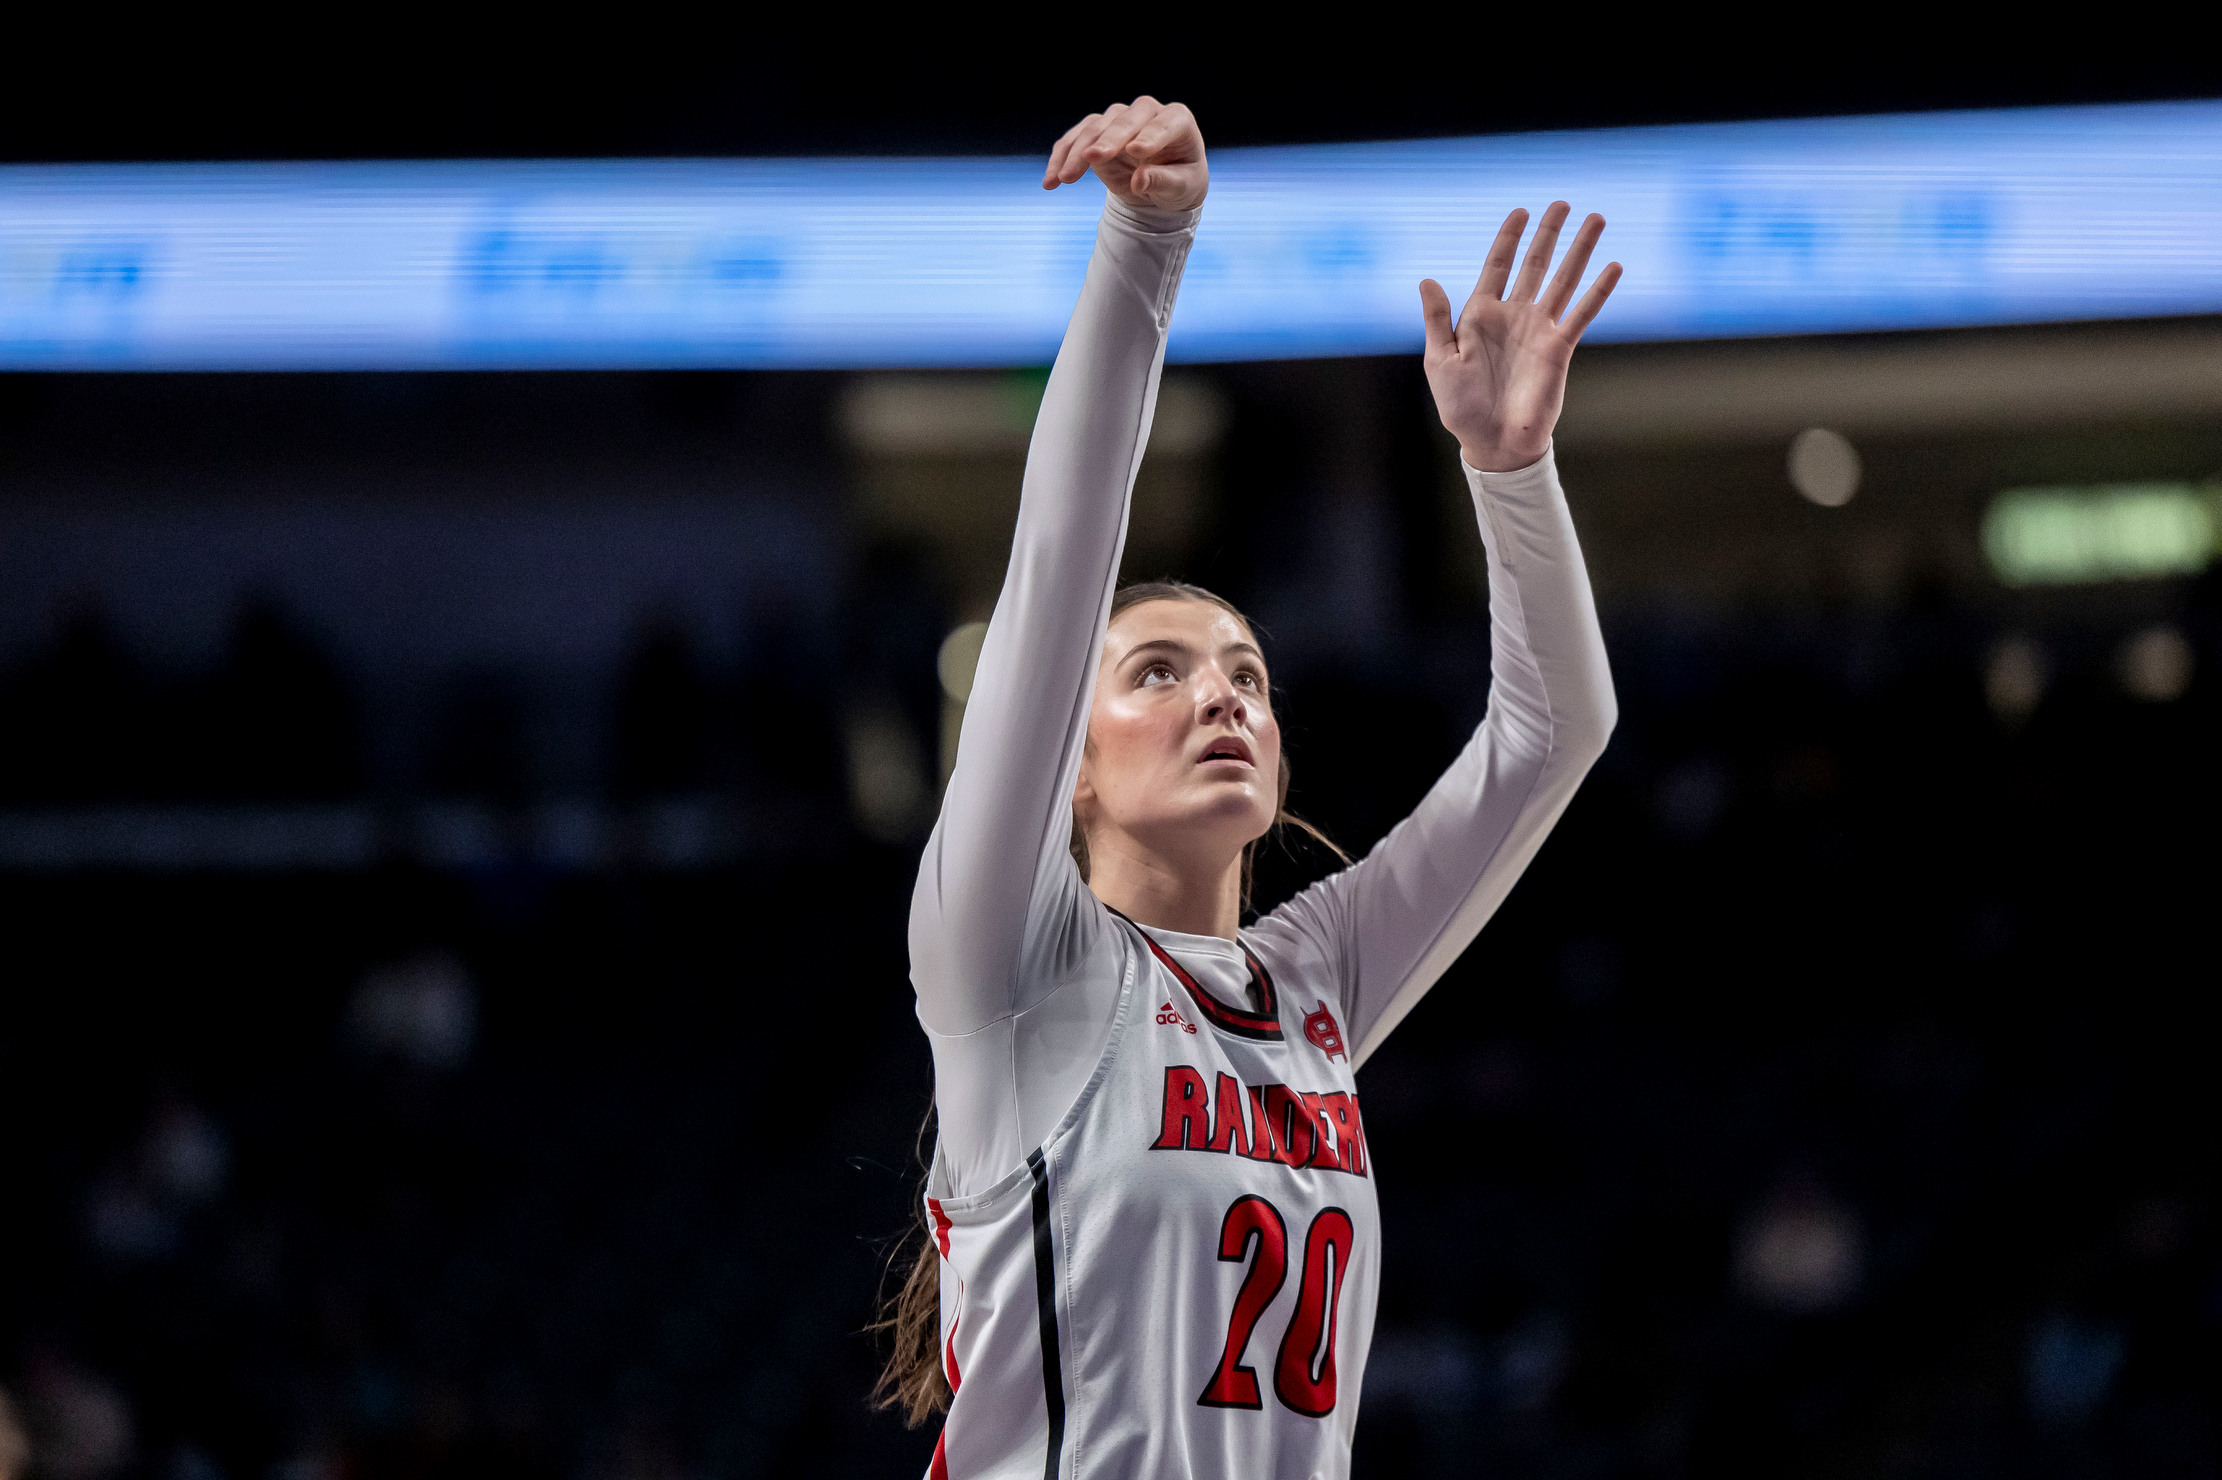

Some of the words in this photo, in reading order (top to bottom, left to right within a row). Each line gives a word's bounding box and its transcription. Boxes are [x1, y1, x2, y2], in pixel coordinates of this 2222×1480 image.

[1156, 1011, 1197, 1034] adas
[1149, 1065, 1367, 1178] RAIDER
[1197, 1194, 1353, 1418] 20
